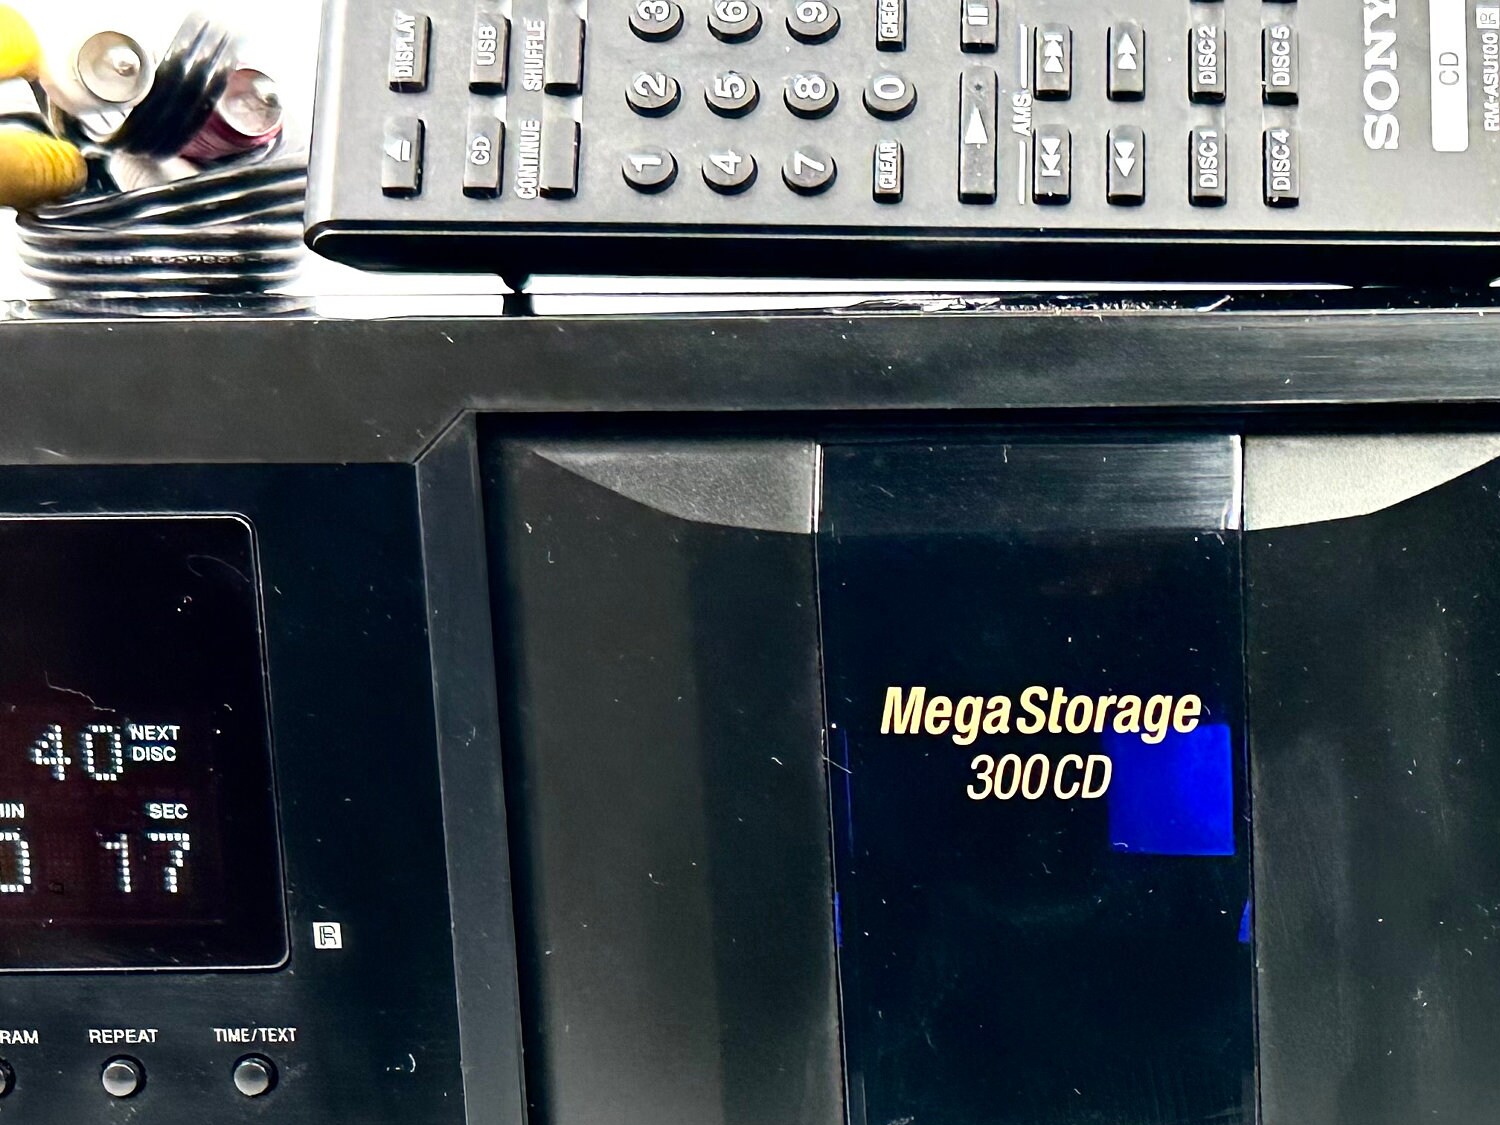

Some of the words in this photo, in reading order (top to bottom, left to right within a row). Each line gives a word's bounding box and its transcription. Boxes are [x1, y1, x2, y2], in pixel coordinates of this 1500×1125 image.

[637, 0, 671, 22] 3
[716, 0, 749, 22] 6
[796, 0, 829, 22] 9
[394, 11, 416, 78] DISPLAY
[476, 25, 497, 66] USB
[522, 18, 545, 91] SHUFFLE
[1363, 0, 1399, 149] SONY
[1438, 52, 1460, 85] CD
[634, 72, 667, 97] 2
[714, 75, 746, 99] 5
[794, 76, 827, 100] 8
[873, 77, 905, 100] 0
[1012, 92, 1032, 137] AMS
[470, 136, 491, 166] CD
[515, 120, 540, 200] CONTINUE
[710, 149, 742, 175] 4
[794, 151, 825, 175] 7
[630, 154, 661, 173] 1
[879, 142, 898, 189] CLEAR
[131, 725, 180, 741] NEXT
[34, 724, 124, 781] 40
[131, 746, 177, 762] DISC
[148, 803, 189, 819] SEC
[103, 832, 190, 893] 17
[88, 1028, 159, 1044] REPEAT
[213, 1027, 298, 1043] TIME/TEXT
